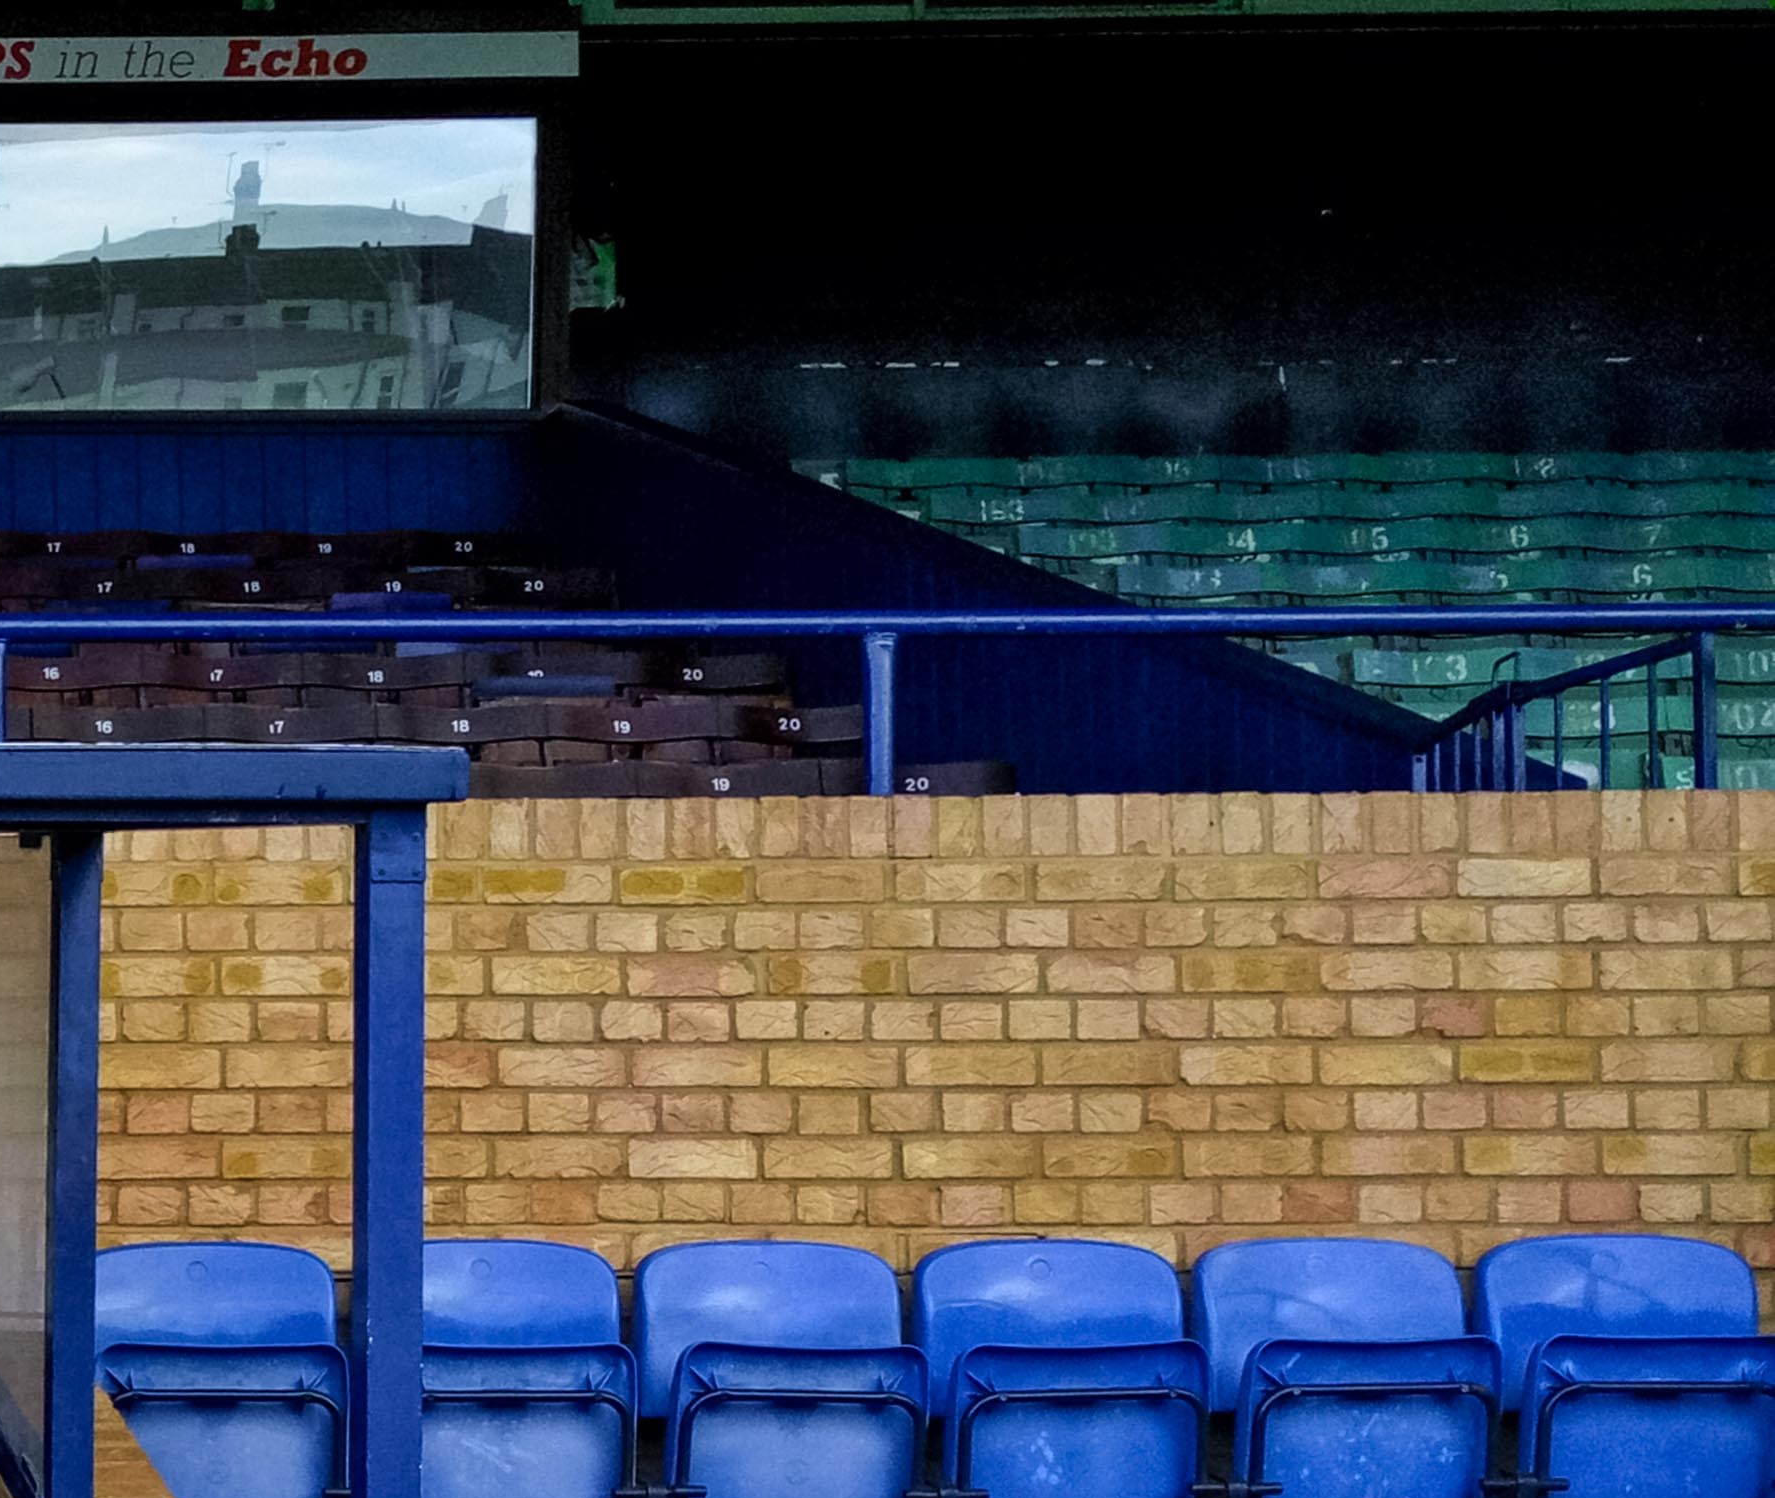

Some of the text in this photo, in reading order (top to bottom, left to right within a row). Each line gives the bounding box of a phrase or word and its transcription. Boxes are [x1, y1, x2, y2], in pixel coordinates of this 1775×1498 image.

[54, 40, 98, 79] in
[123, 40, 196, 79] the
[223, 39, 368, 77] Echo
[42, 666, 60, 680] 16
[367, 670, 384, 683] 18
[682, 668, 704, 681] 20
[95, 720, 113, 734] 16
[451, 719, 470, 733] 18
[613, 720, 631, 734] 19
[778, 717, 801, 731] 20
[711, 777, 730, 792] 19
[905, 777, 929, 792] 20
